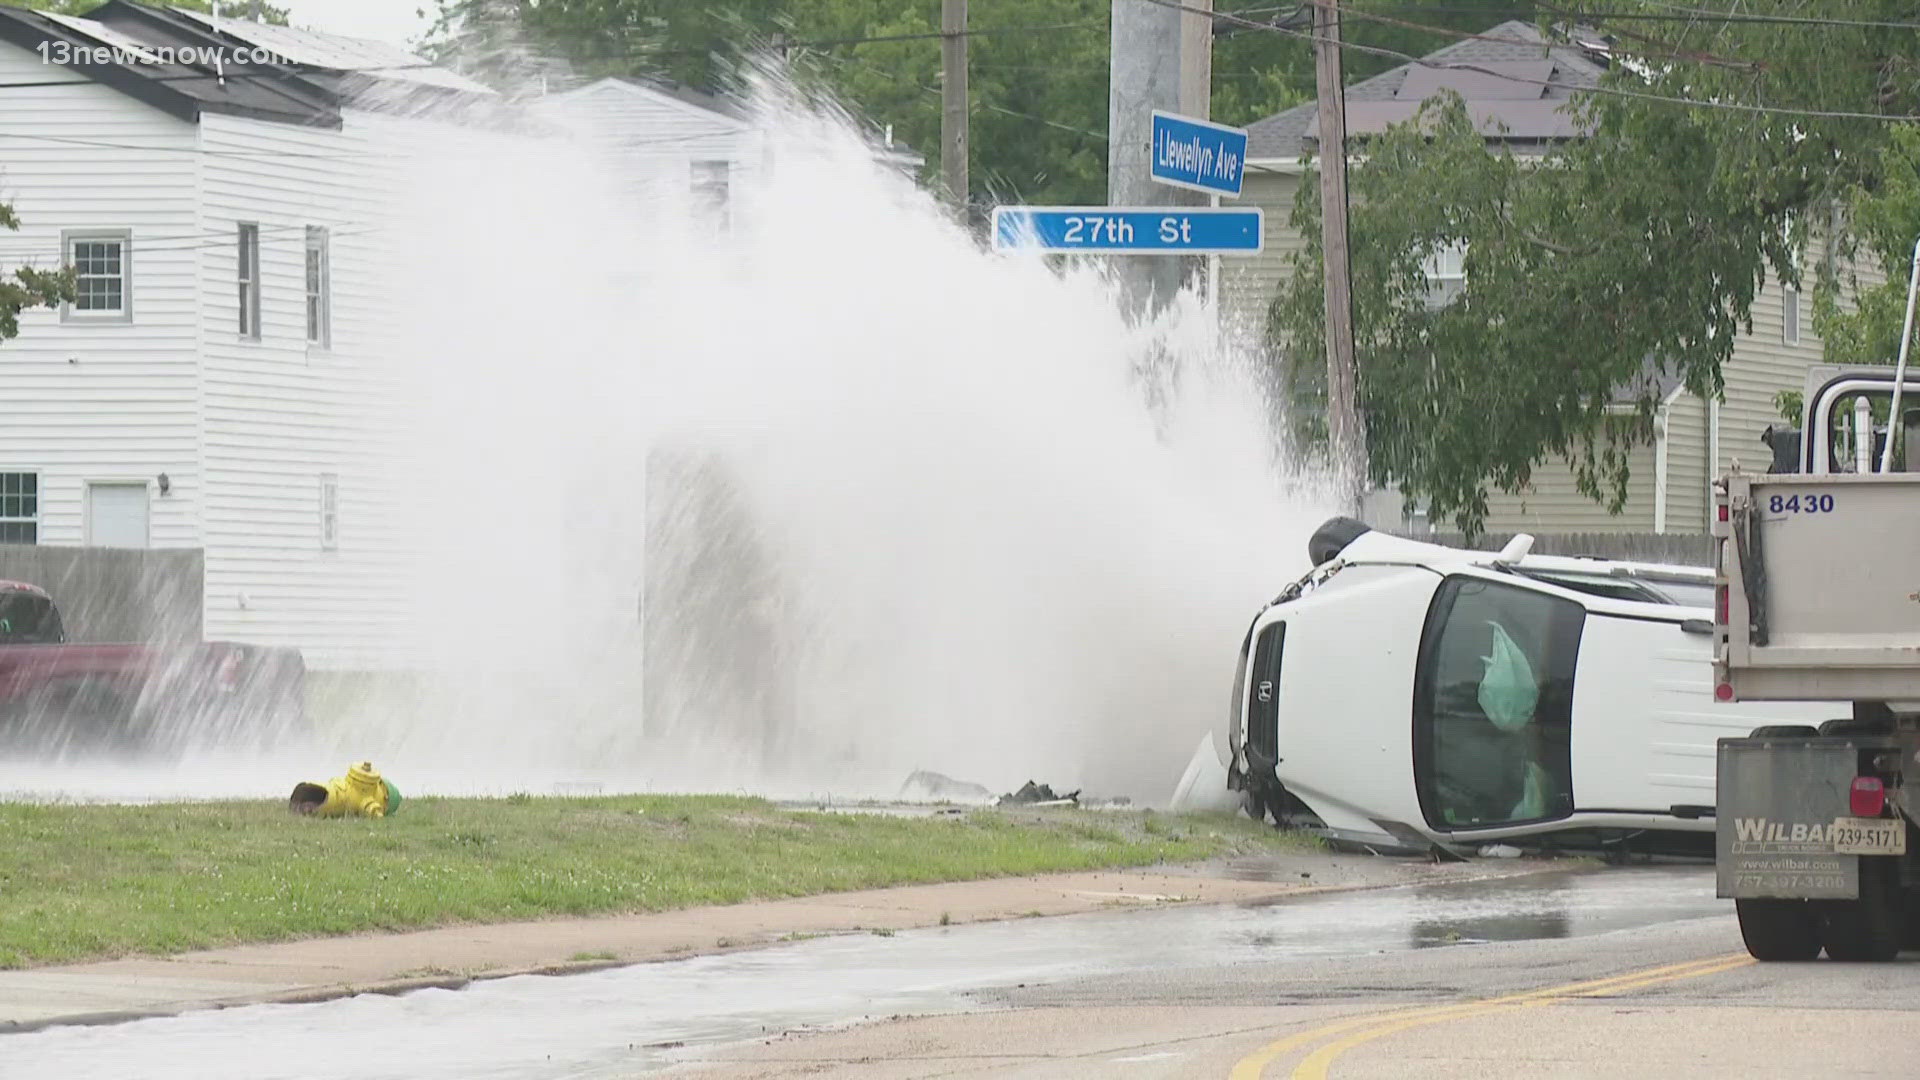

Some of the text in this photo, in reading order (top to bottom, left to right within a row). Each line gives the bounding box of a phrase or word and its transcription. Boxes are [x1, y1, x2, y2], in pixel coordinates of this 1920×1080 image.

[1159, 128, 1237, 184] Llewellyn Ave
[1064, 217, 1191, 243] 27th St
[1769, 494, 1834, 513] 8430
[1742, 859, 1840, 870] www.wilbar.com
